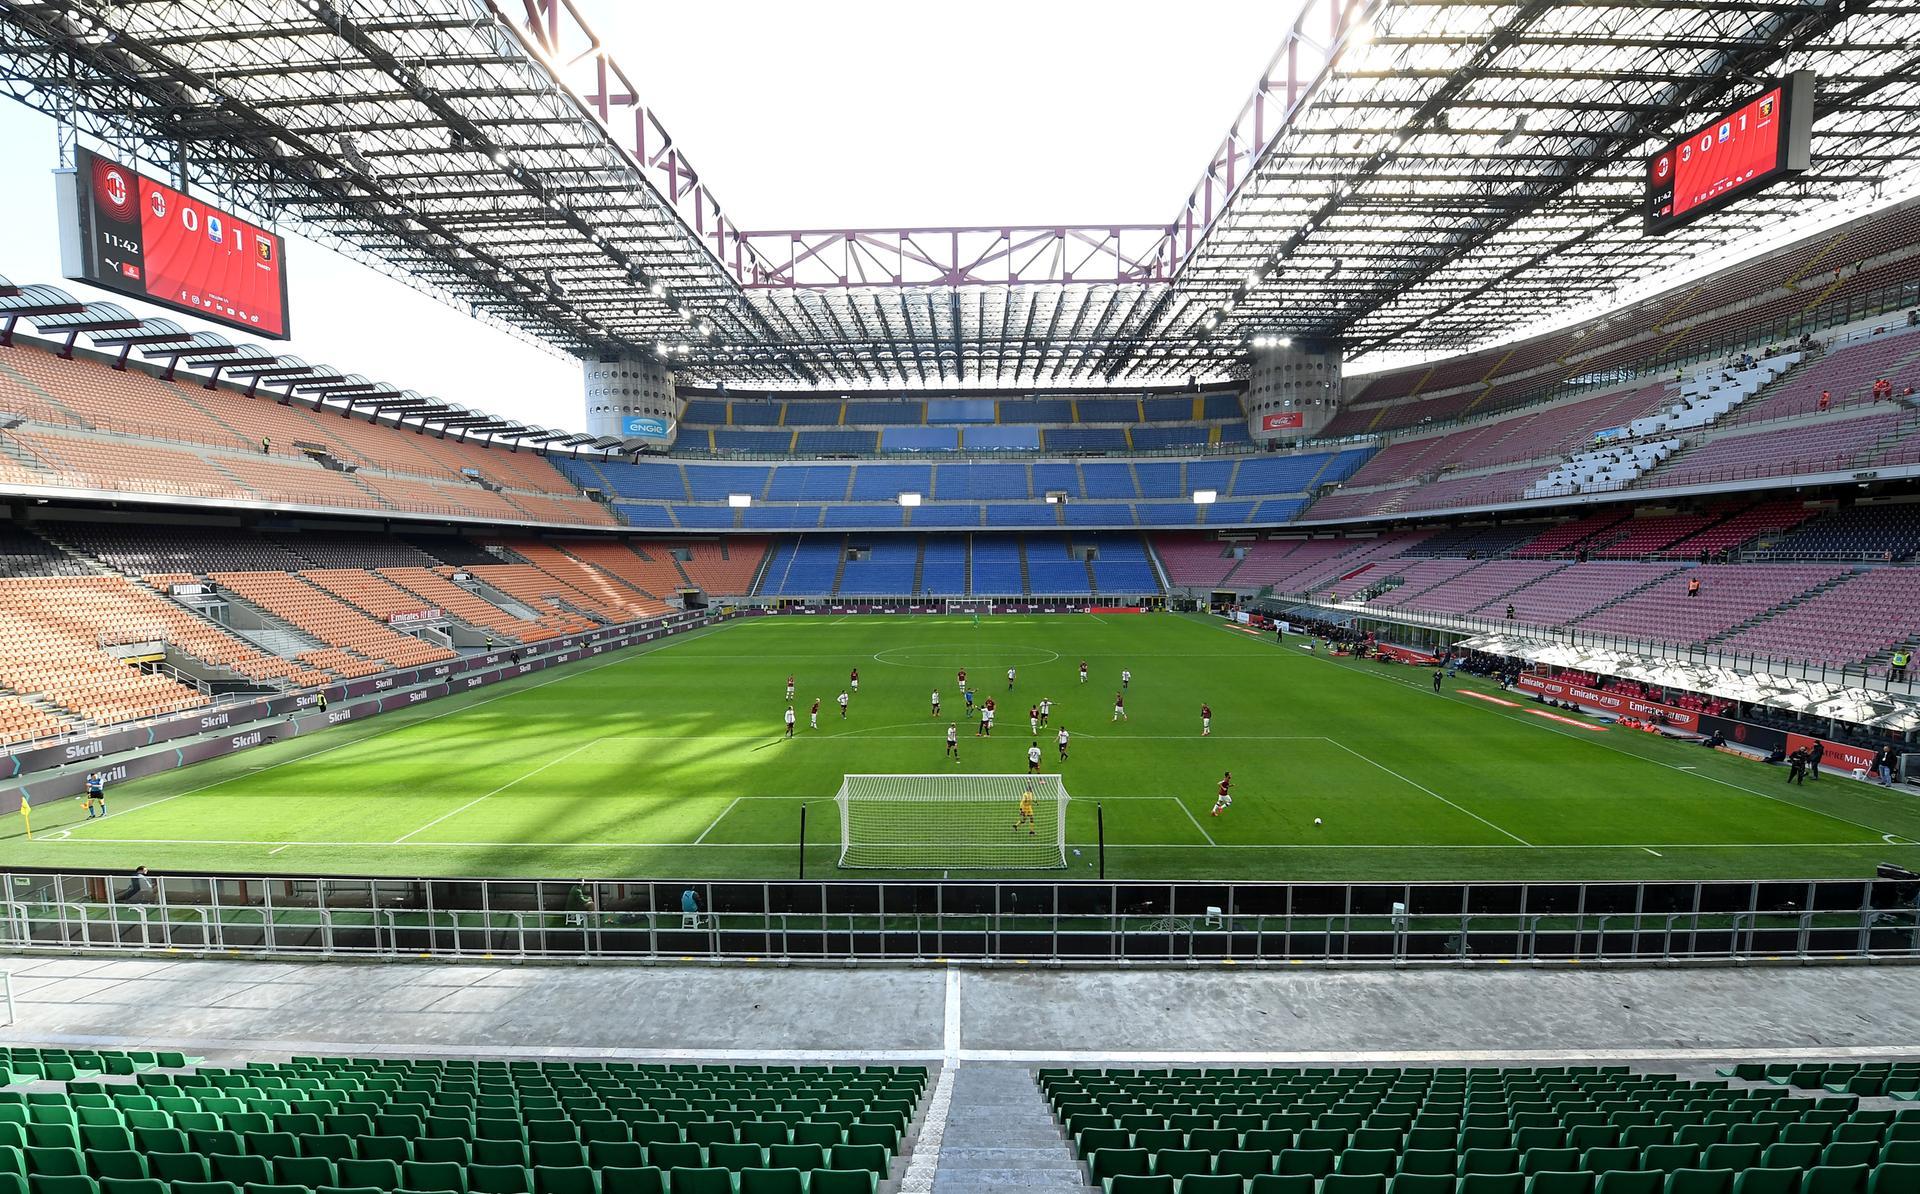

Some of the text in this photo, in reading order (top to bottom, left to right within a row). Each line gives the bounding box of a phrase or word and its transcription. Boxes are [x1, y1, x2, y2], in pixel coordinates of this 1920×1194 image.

[1701, 134, 1712, 152] 0
[1739, 114, 1747, 131] 1
[182, 207, 198, 232] 0
[232, 228, 243, 252] 1
[103, 231, 139, 254] 11:42
[390, 612, 420, 623] Emirates
[375, 678, 393, 689] Skrill
[1520, 676, 1545, 689] Emirates
[296, 693, 318, 707] Skrill
[409, 691, 427, 702] Skrill
[1570, 687, 1599, 701] Emirates
[1629, 701, 1664, 716] Emirates
[201, 713, 229, 729] Skrill
[328, 709, 351, 723] Skrill
[232, 732, 261, 748] Skrill
[65, 740, 103, 759] Skrill
